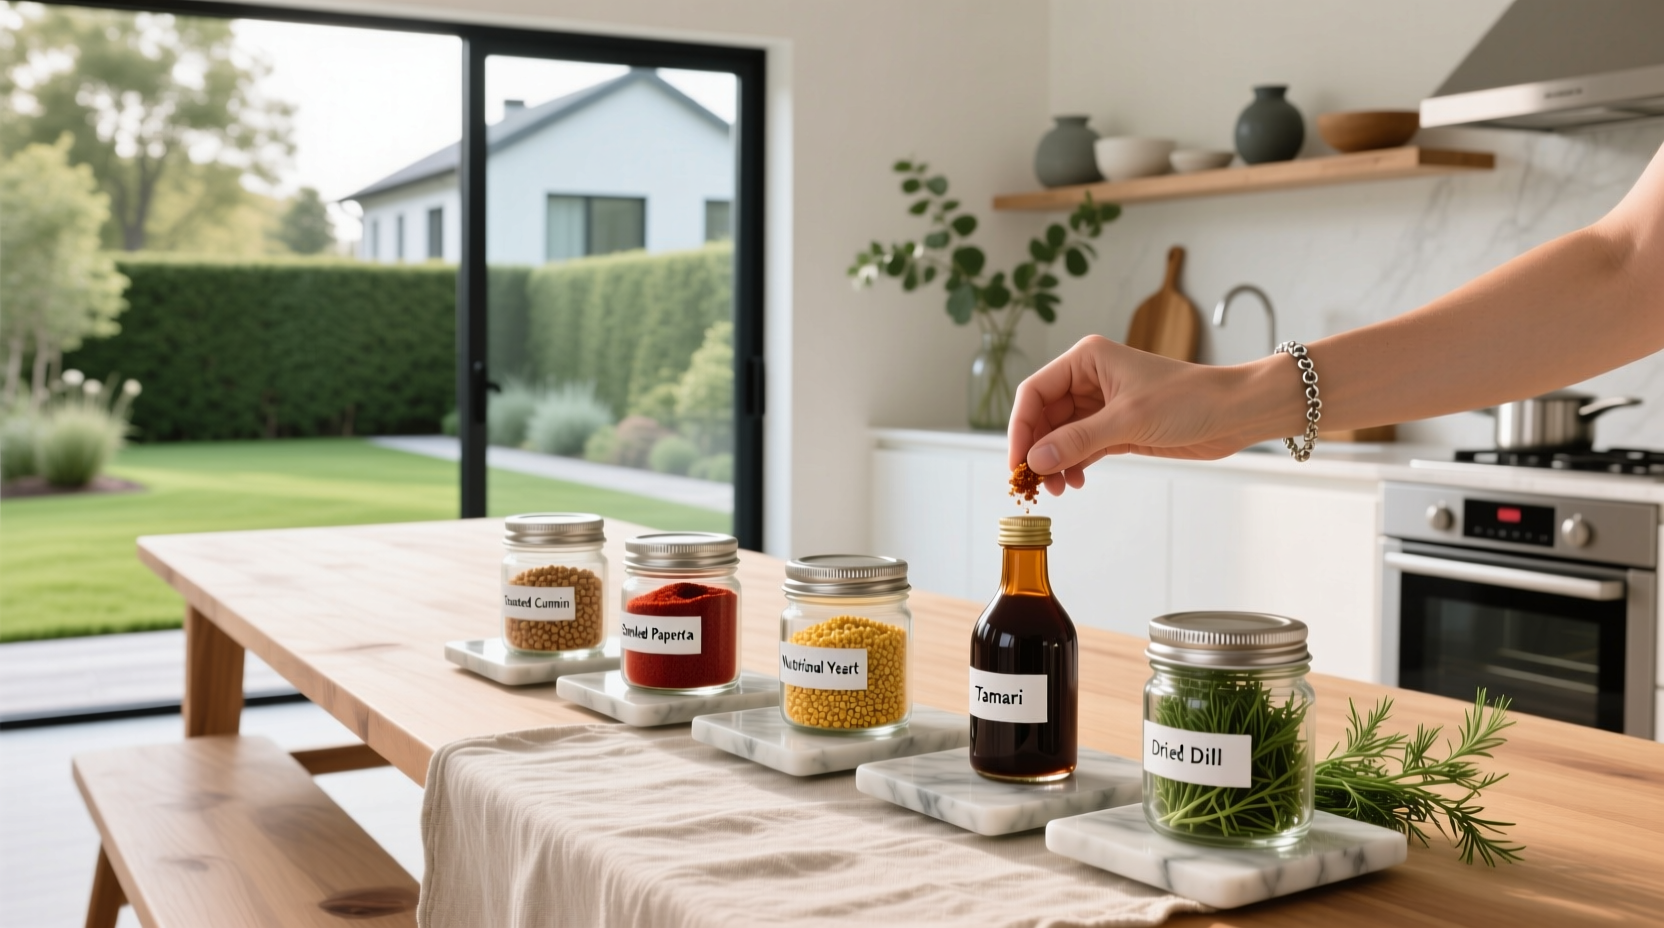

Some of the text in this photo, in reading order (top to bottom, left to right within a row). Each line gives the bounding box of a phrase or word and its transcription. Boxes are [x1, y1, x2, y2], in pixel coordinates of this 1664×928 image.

[974, 685, 1023, 705] Tamari
[1152, 739, 1222, 766] Dried Dill
